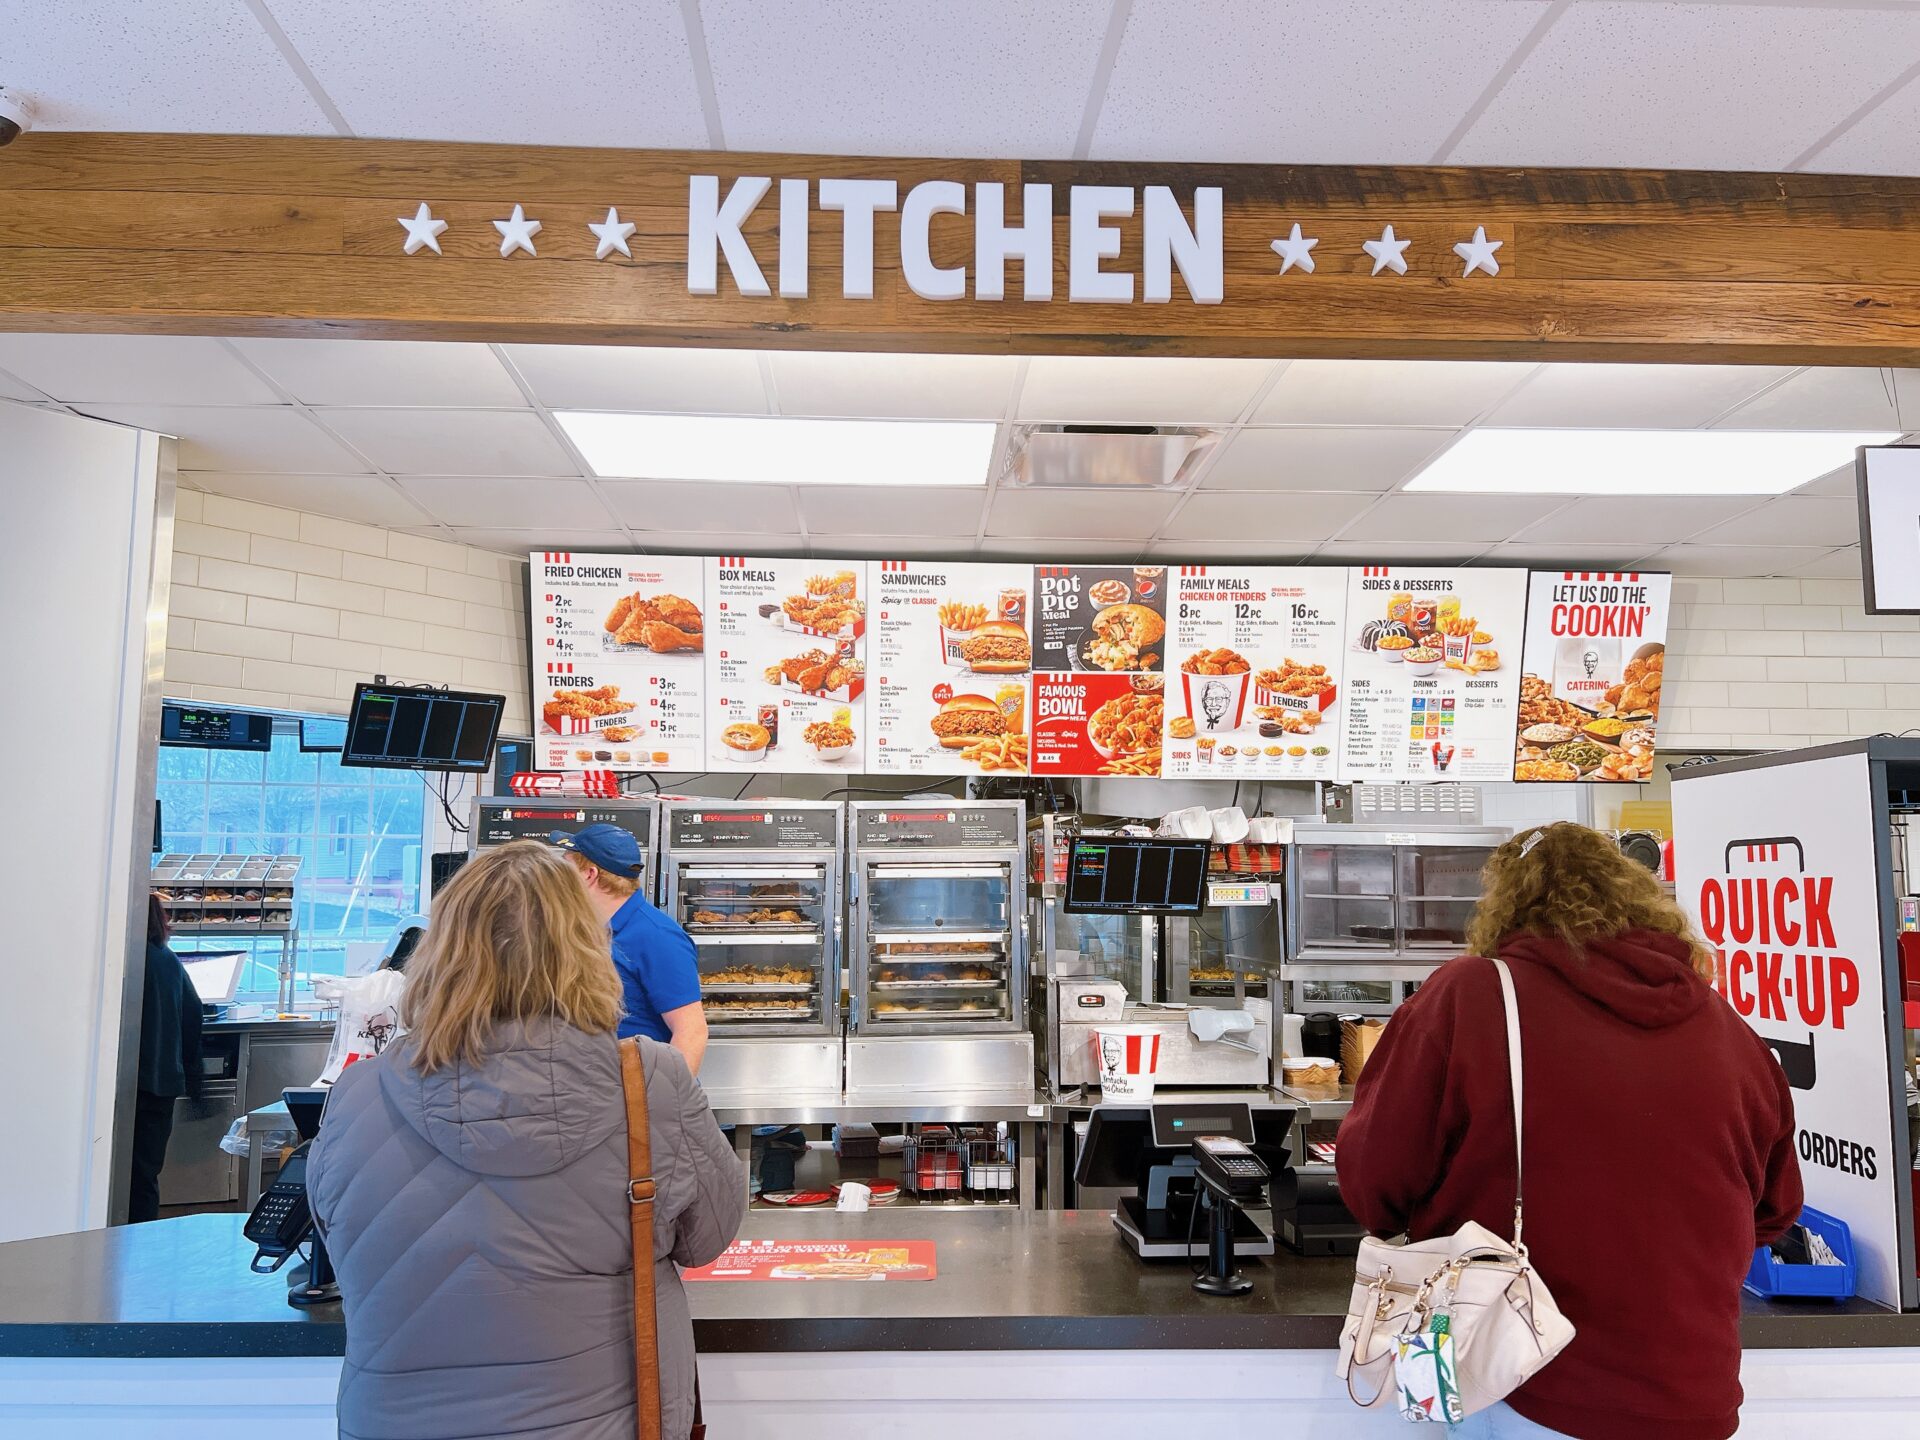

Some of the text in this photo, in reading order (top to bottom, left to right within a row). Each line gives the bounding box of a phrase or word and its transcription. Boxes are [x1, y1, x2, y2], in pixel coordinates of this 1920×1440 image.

[687, 175, 1223, 304] KITCHEN
[545, 566, 622, 579] FRIED CHICKEN
[720, 570, 775, 582] BOX MEALS
[881, 574, 947, 586] SANDWICHES
[1040, 574, 1081, 595] Pot
[1181, 579, 1250, 591] FAMILY MEALS
[1362, 580, 1454, 591] SIDES & DESSERTS
[555, 594, 563, 606] 2
[881, 596, 902, 605] Spicy
[1179, 592, 1266, 601] CHICKEN OR TENDERS
[1553, 585, 1648, 604] LET US DO THE
[1041, 592, 1079, 612] Pie
[1043, 610, 1071, 620] Meal
[1179, 604, 1201, 618] 8 PC
[1235, 604, 1262, 618] 12 PC
[1291, 604, 1319, 618] 16 PC
[556, 617, 563, 628] 3
[556, 639, 564, 650] 4
[948, 645, 964, 659] FRI
[1447, 647, 1463, 658] FRIES
[547, 676, 594, 687] TENDERS
[659, 678, 666, 689] 3
[1465, 681, 1499, 689] DESSERTS
[1567, 680, 1610, 691] CATERING
[1039, 685, 1086, 697] FAMOUS
[659, 699, 667, 710] 4
[1038, 698, 1087, 716] BOWL
[1272, 695, 1309, 710] TENDERS
[594, 716, 628, 728] TENDERS
[660, 720, 667, 731] 5
[1172, 751, 1191, 759] SIDES
[1700, 877, 1838, 948] QUICK
[1702, 948, 1860, 1030] ICK-UP
[1111, 1084, 1135, 1094] Chicken
[1798, 1128, 1878, 1181] ORDERS
